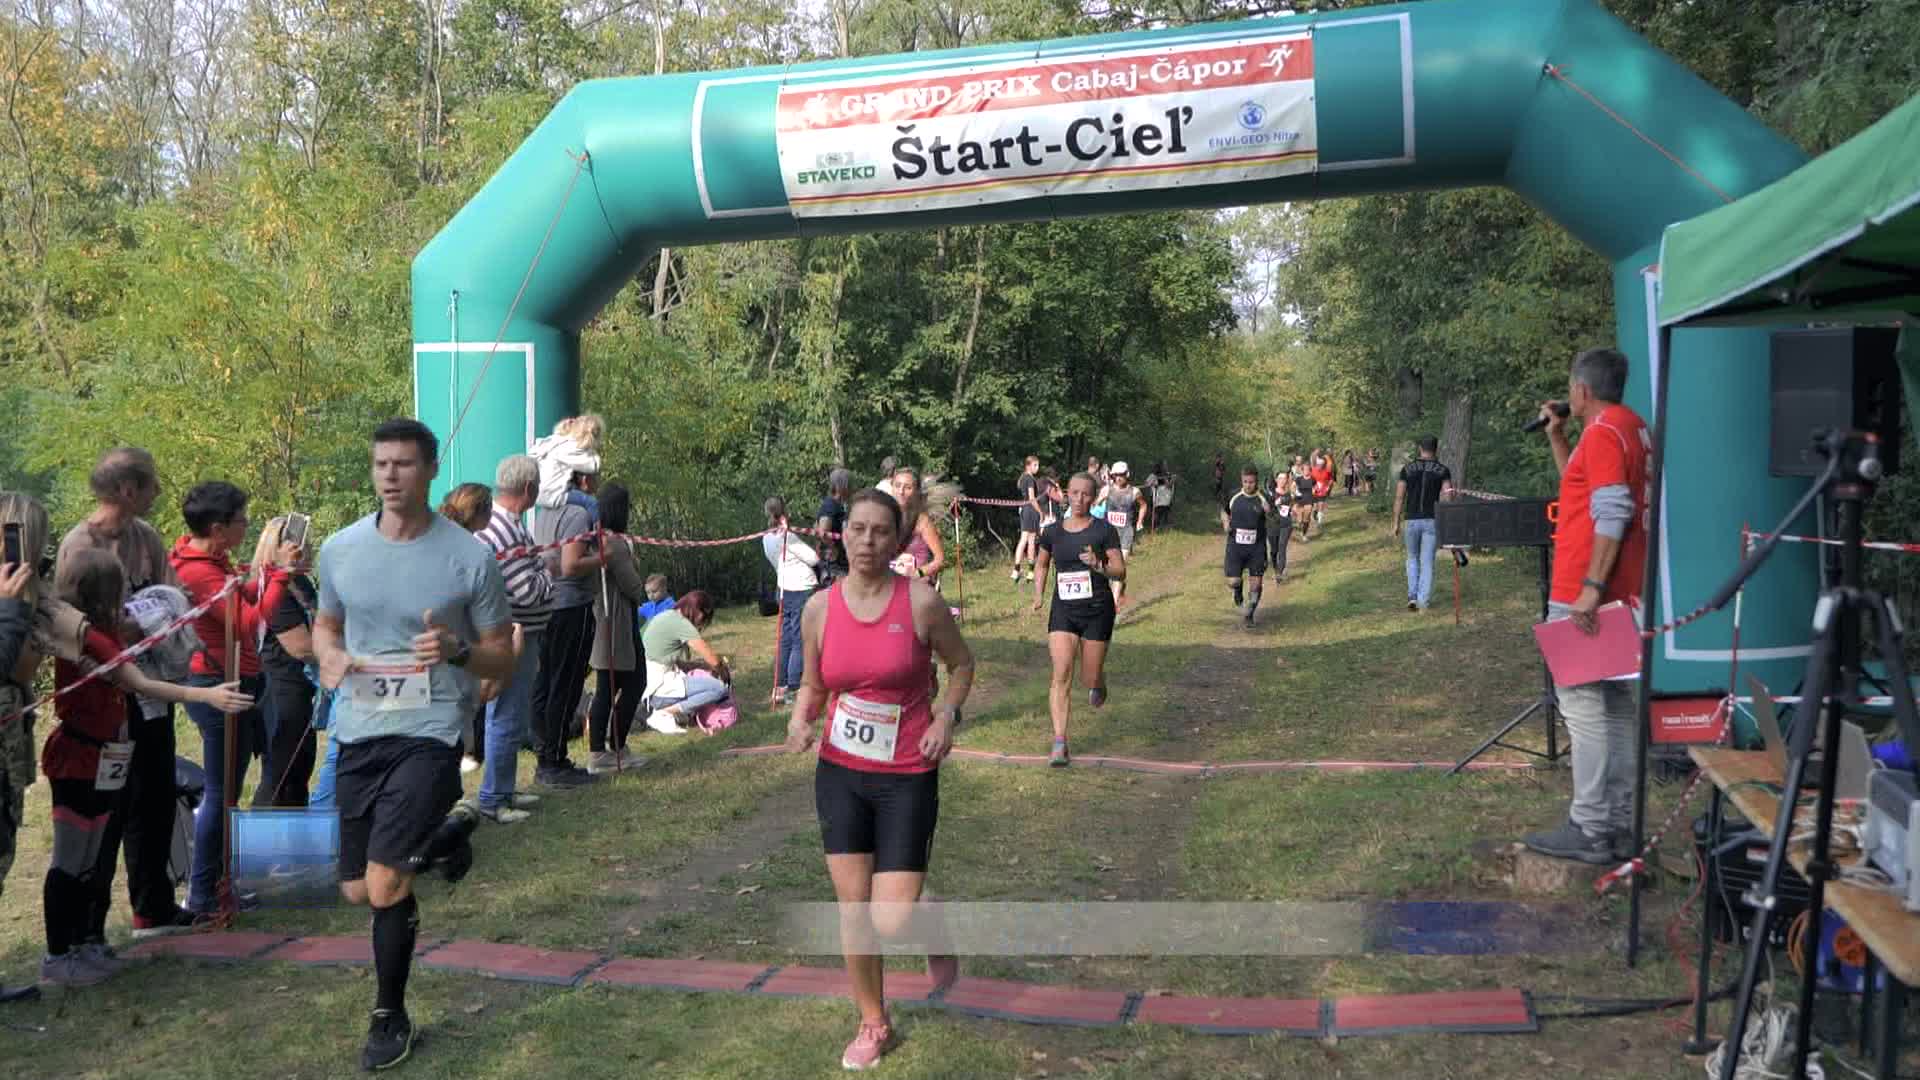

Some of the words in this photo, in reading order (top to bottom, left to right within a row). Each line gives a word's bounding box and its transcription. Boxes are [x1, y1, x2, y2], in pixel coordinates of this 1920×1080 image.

[964, 75, 1042, 102] PRIX
[1051, 58, 1247, 93] Cabaj-Čápor
[892, 106, 1194, 181] Štart-Cieľ
[797, 165, 876, 185] STAVEKO
[1065, 583, 1082, 594] 73
[373, 677, 407, 697] 37
[843, 719, 875, 744] 50
